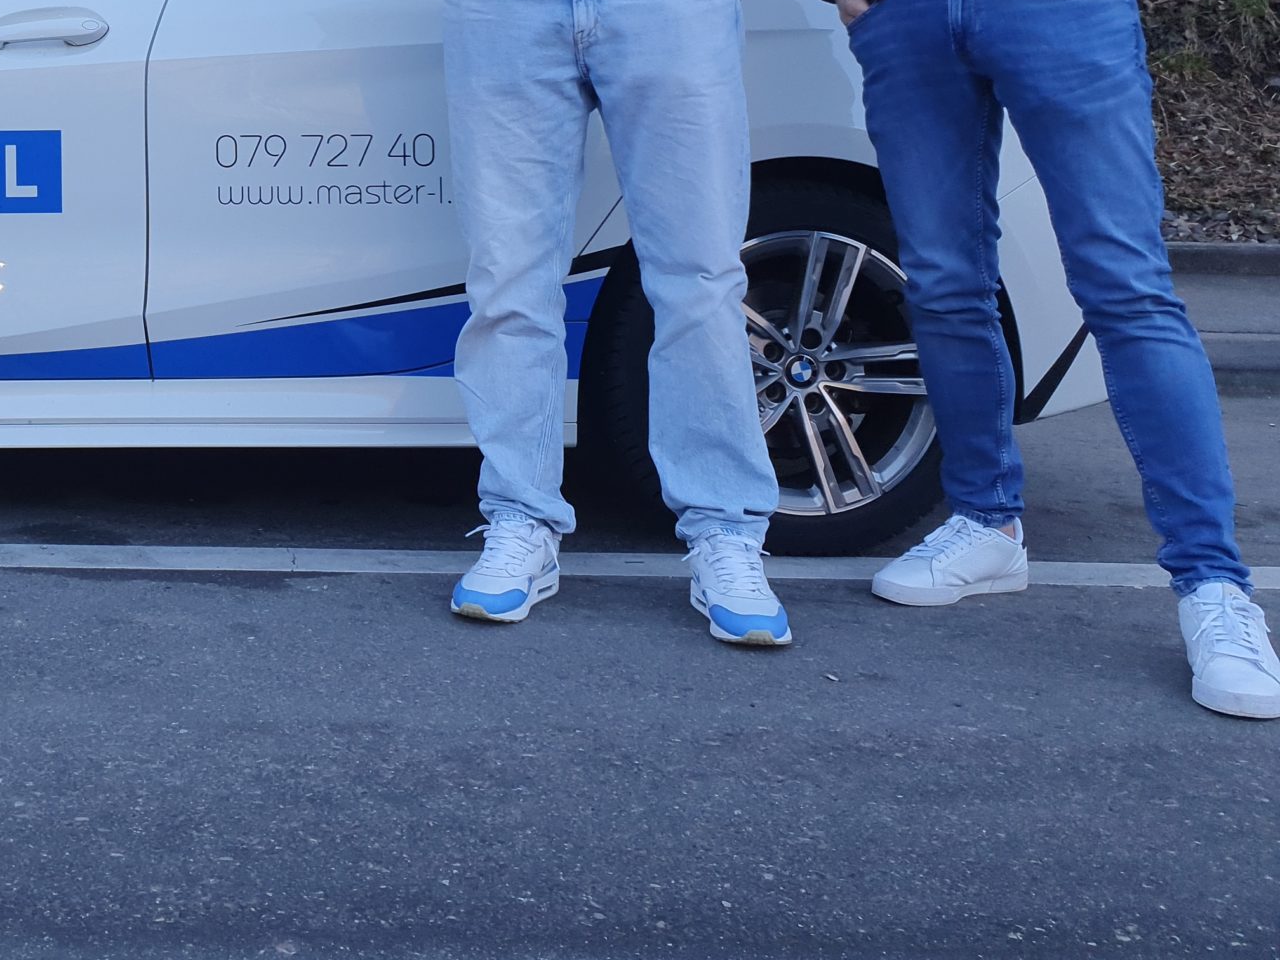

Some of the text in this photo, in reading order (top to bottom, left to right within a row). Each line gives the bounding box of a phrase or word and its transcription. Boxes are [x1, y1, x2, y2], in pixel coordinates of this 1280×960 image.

[215, 133, 436, 168] 079 727 40
